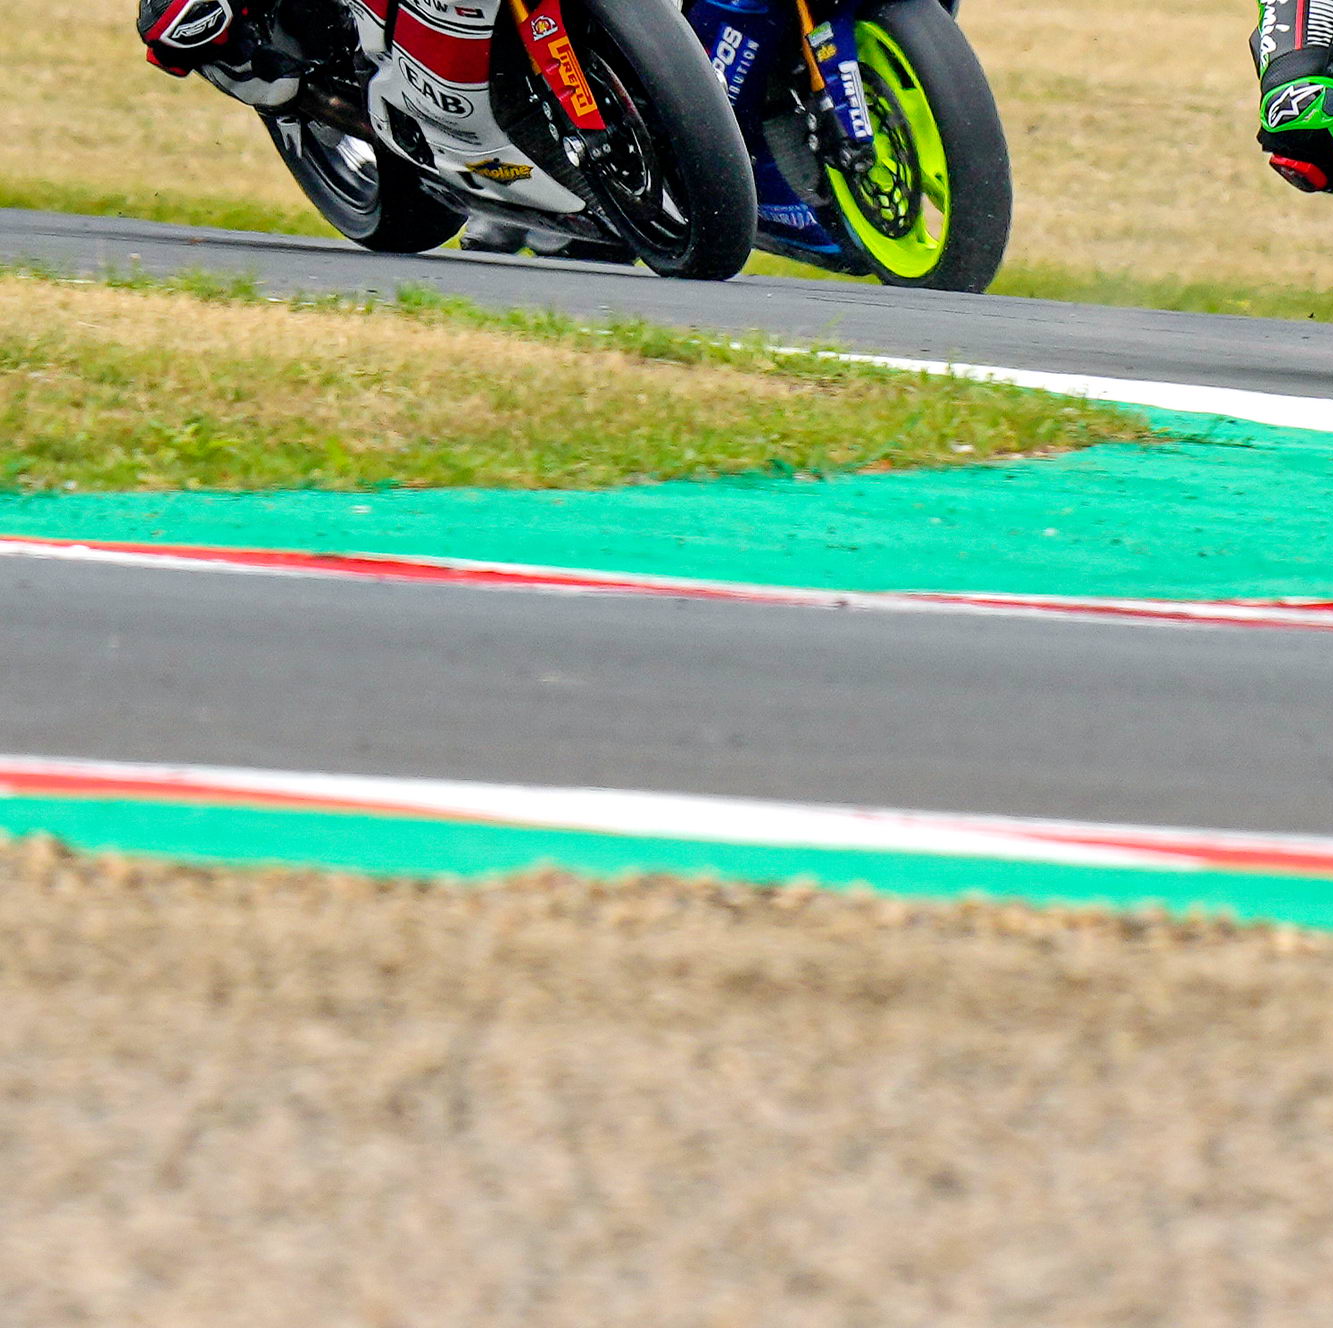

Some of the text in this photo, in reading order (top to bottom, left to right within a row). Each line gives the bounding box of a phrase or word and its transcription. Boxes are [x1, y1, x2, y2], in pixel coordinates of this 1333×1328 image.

[171, 7, 224, 40] RST
[404, 58, 467, 115] EAB
[549, 36, 598, 117] PIRELLI
